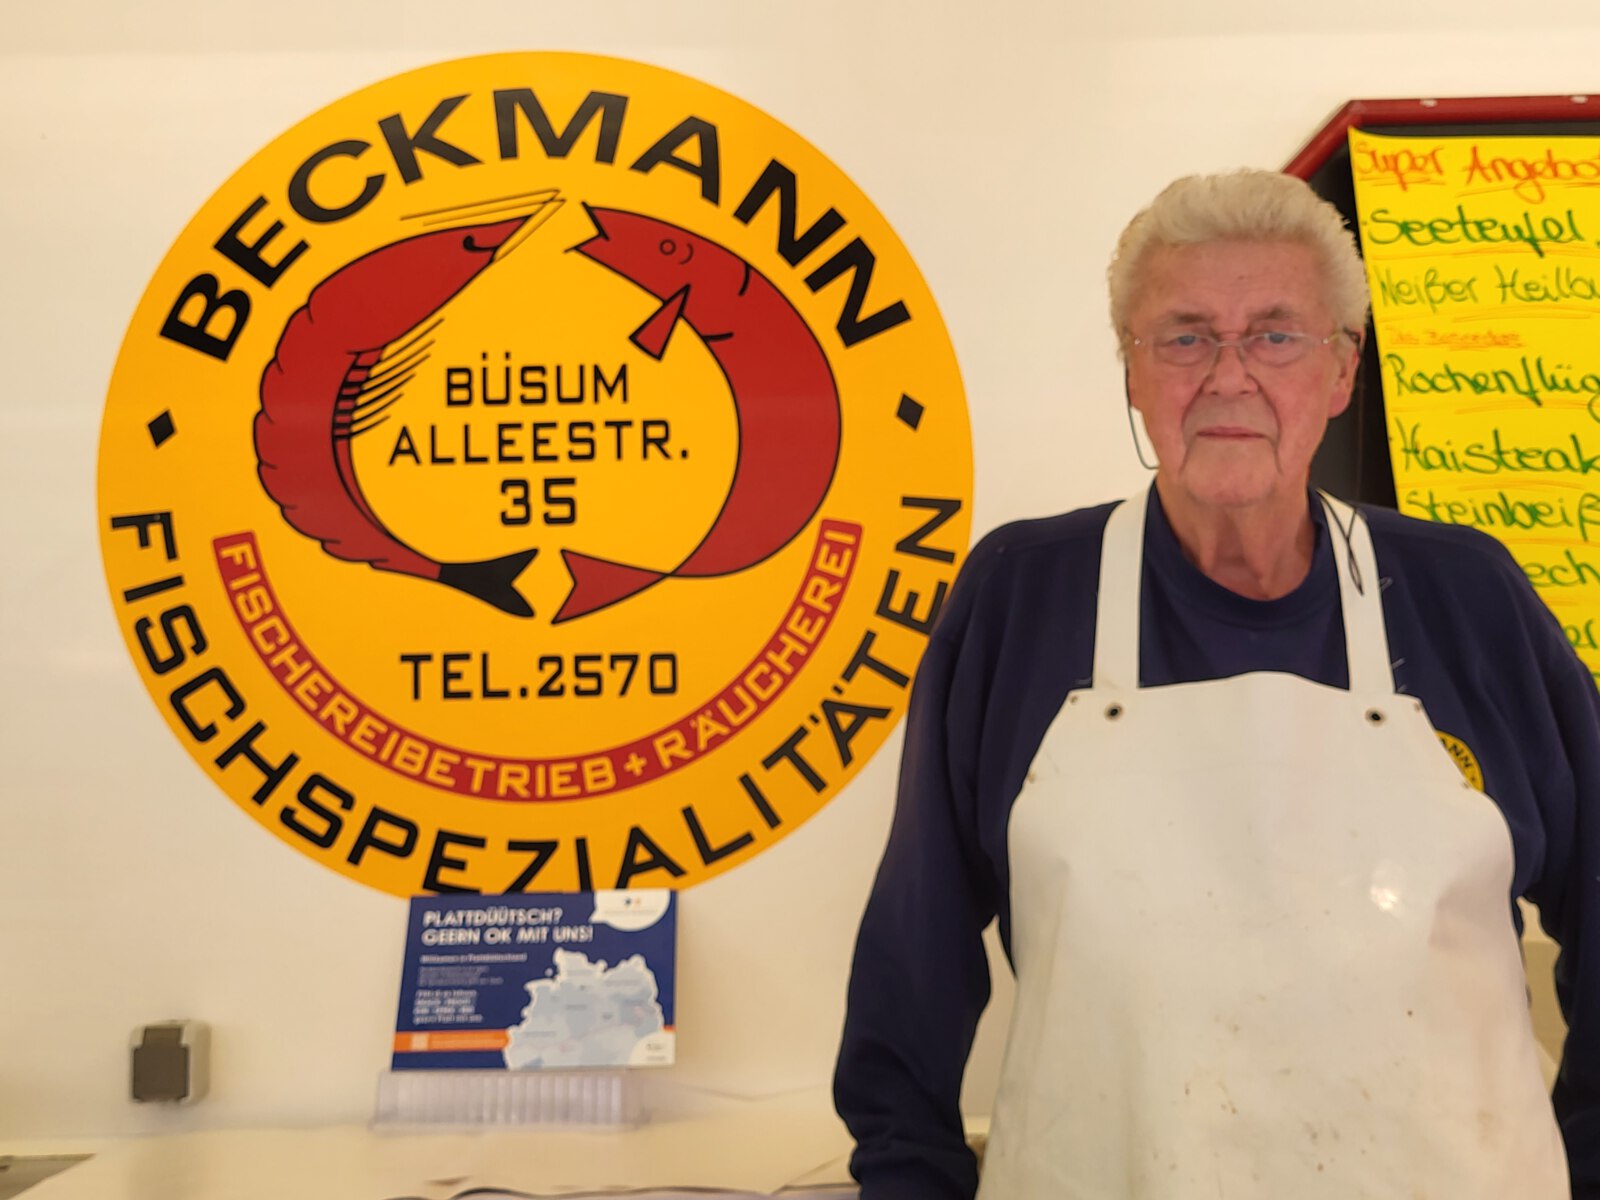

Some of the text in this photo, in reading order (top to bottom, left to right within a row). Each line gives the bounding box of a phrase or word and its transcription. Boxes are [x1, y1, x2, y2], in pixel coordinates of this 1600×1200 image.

[1356, 141, 1600, 204] Super Angebo
[159, 87, 911, 362] BECKMANN
[1367, 205, 1585, 258] Seeteufel
[446, 351, 628, 407] BÜSUM
[389, 420, 688, 466] ALLEESTR.
[500, 477, 577, 526] 35
[219, 541, 616, 797] FISCHEREIBETRIEB
[653, 529, 857, 769] RÄUCHEREI
[111, 496, 962, 895] FISCHSPEZIALITÄTEN
[1440, 738, 1474, 769] NN
[421, 925, 594, 946] GEERN OK MIT UNS!
[422, 905, 563, 928] PLATTDÜÜTSCH?
